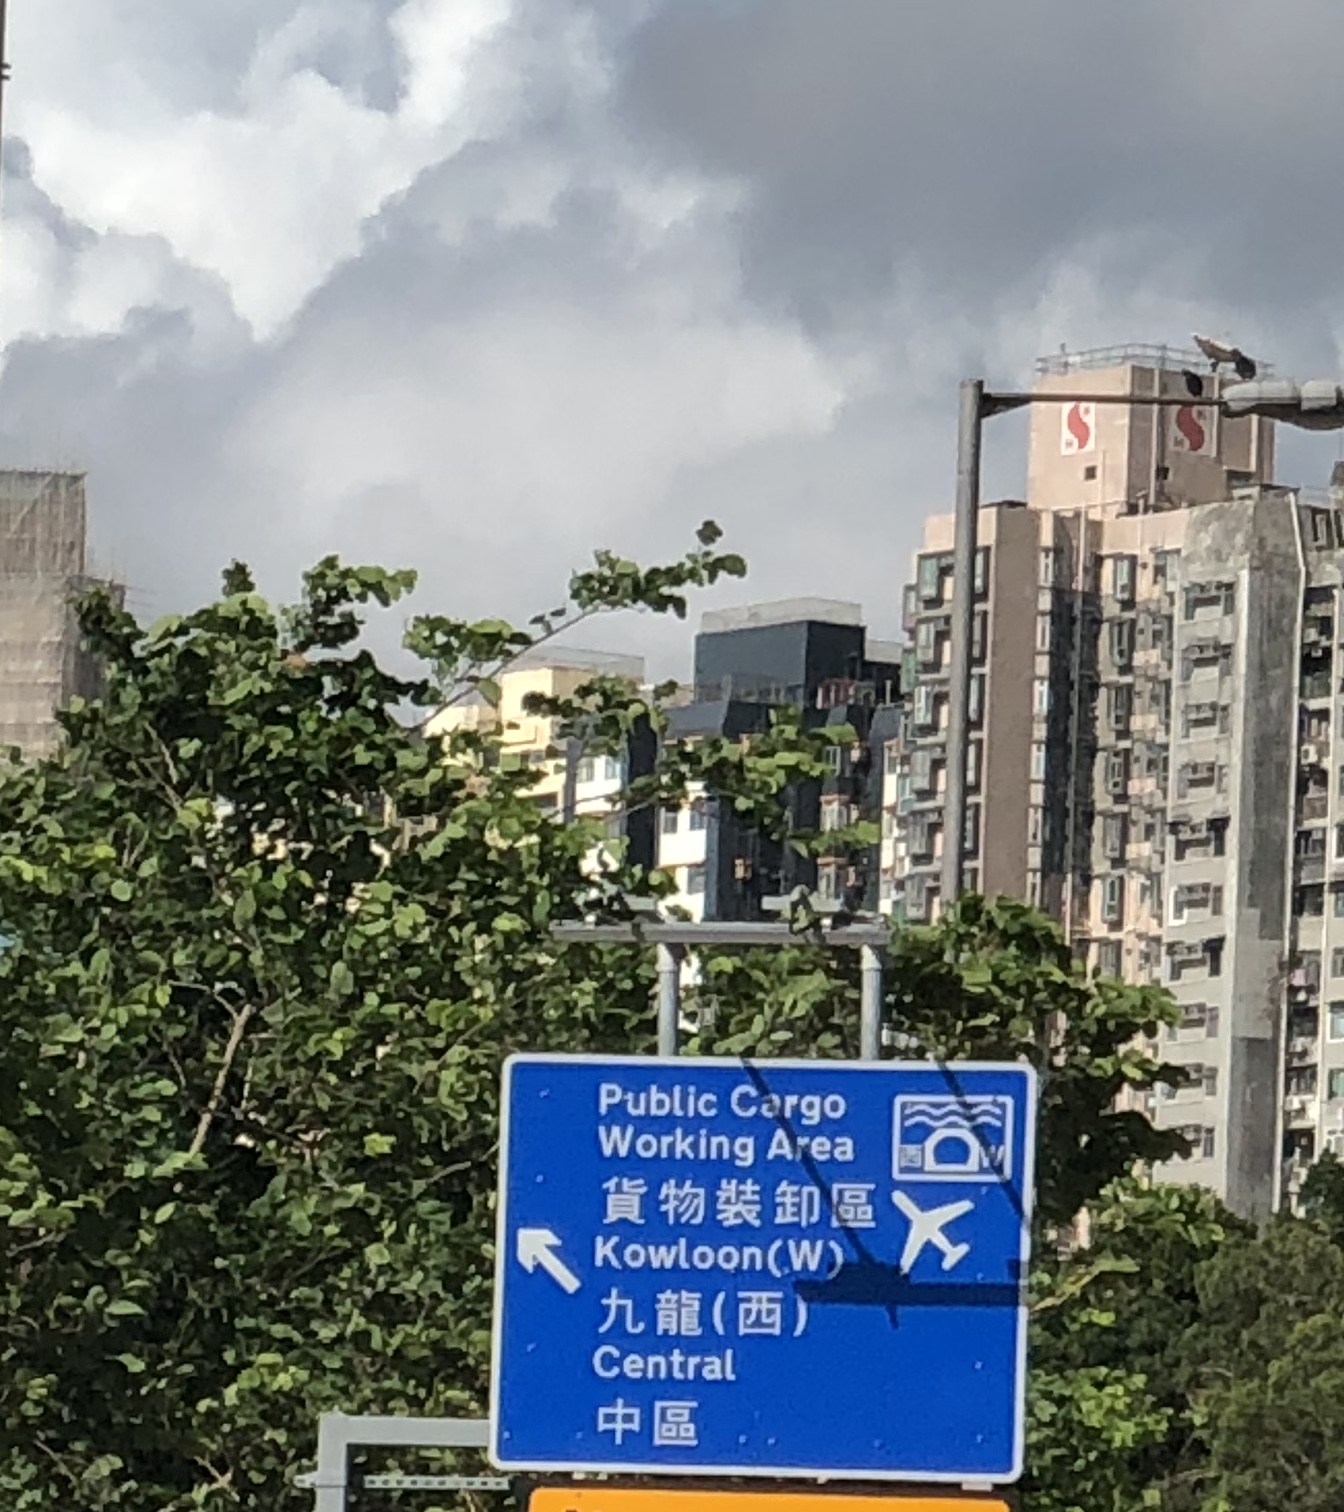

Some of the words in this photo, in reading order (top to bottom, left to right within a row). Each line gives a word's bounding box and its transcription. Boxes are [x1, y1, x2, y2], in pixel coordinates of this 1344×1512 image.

[599, 1083, 717, 1118] Public
[730, 1085, 846, 1120] Cargo
[598, 1125, 755, 1167] Working
[767, 1127, 854, 1162] Area
[602, 1177, 876, 1228] 貨物裝卸區
[594, 1236, 844, 1278] Kowloon(W)
[598, 1289, 807, 1336] 九龍(西)
[592, 1345, 736, 1381] Central
[597, 1398, 698, 1446] 中區
